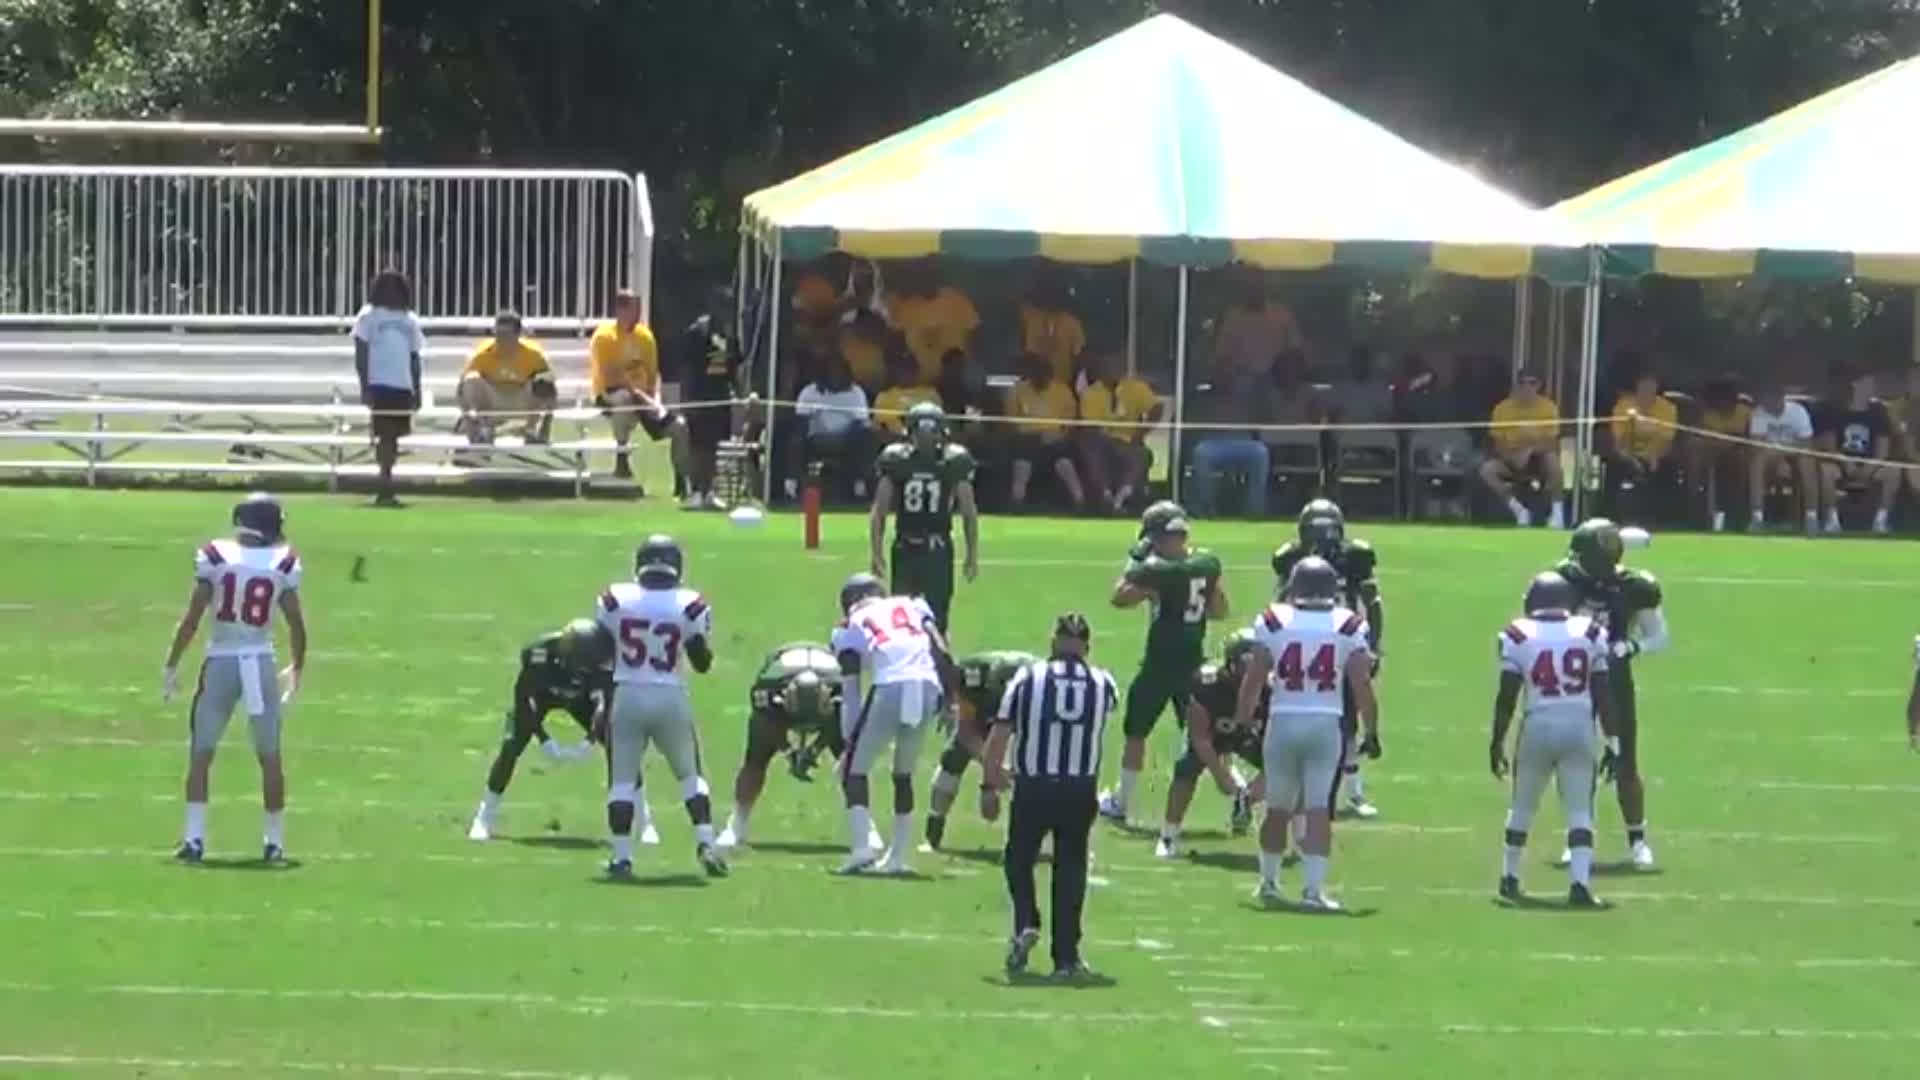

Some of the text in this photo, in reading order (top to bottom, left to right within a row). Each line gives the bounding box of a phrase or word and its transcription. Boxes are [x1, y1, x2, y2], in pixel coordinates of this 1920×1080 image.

[904, 480, 940, 513] 81
[217, 572, 274, 627] 18
[1184, 577, 1206, 622] 5
[620, 617, 681, 673] 53
[1278, 642, 1337, 692] 44
[1531, 648, 1588, 697] 49
[1054, 679, 1087, 720] U
